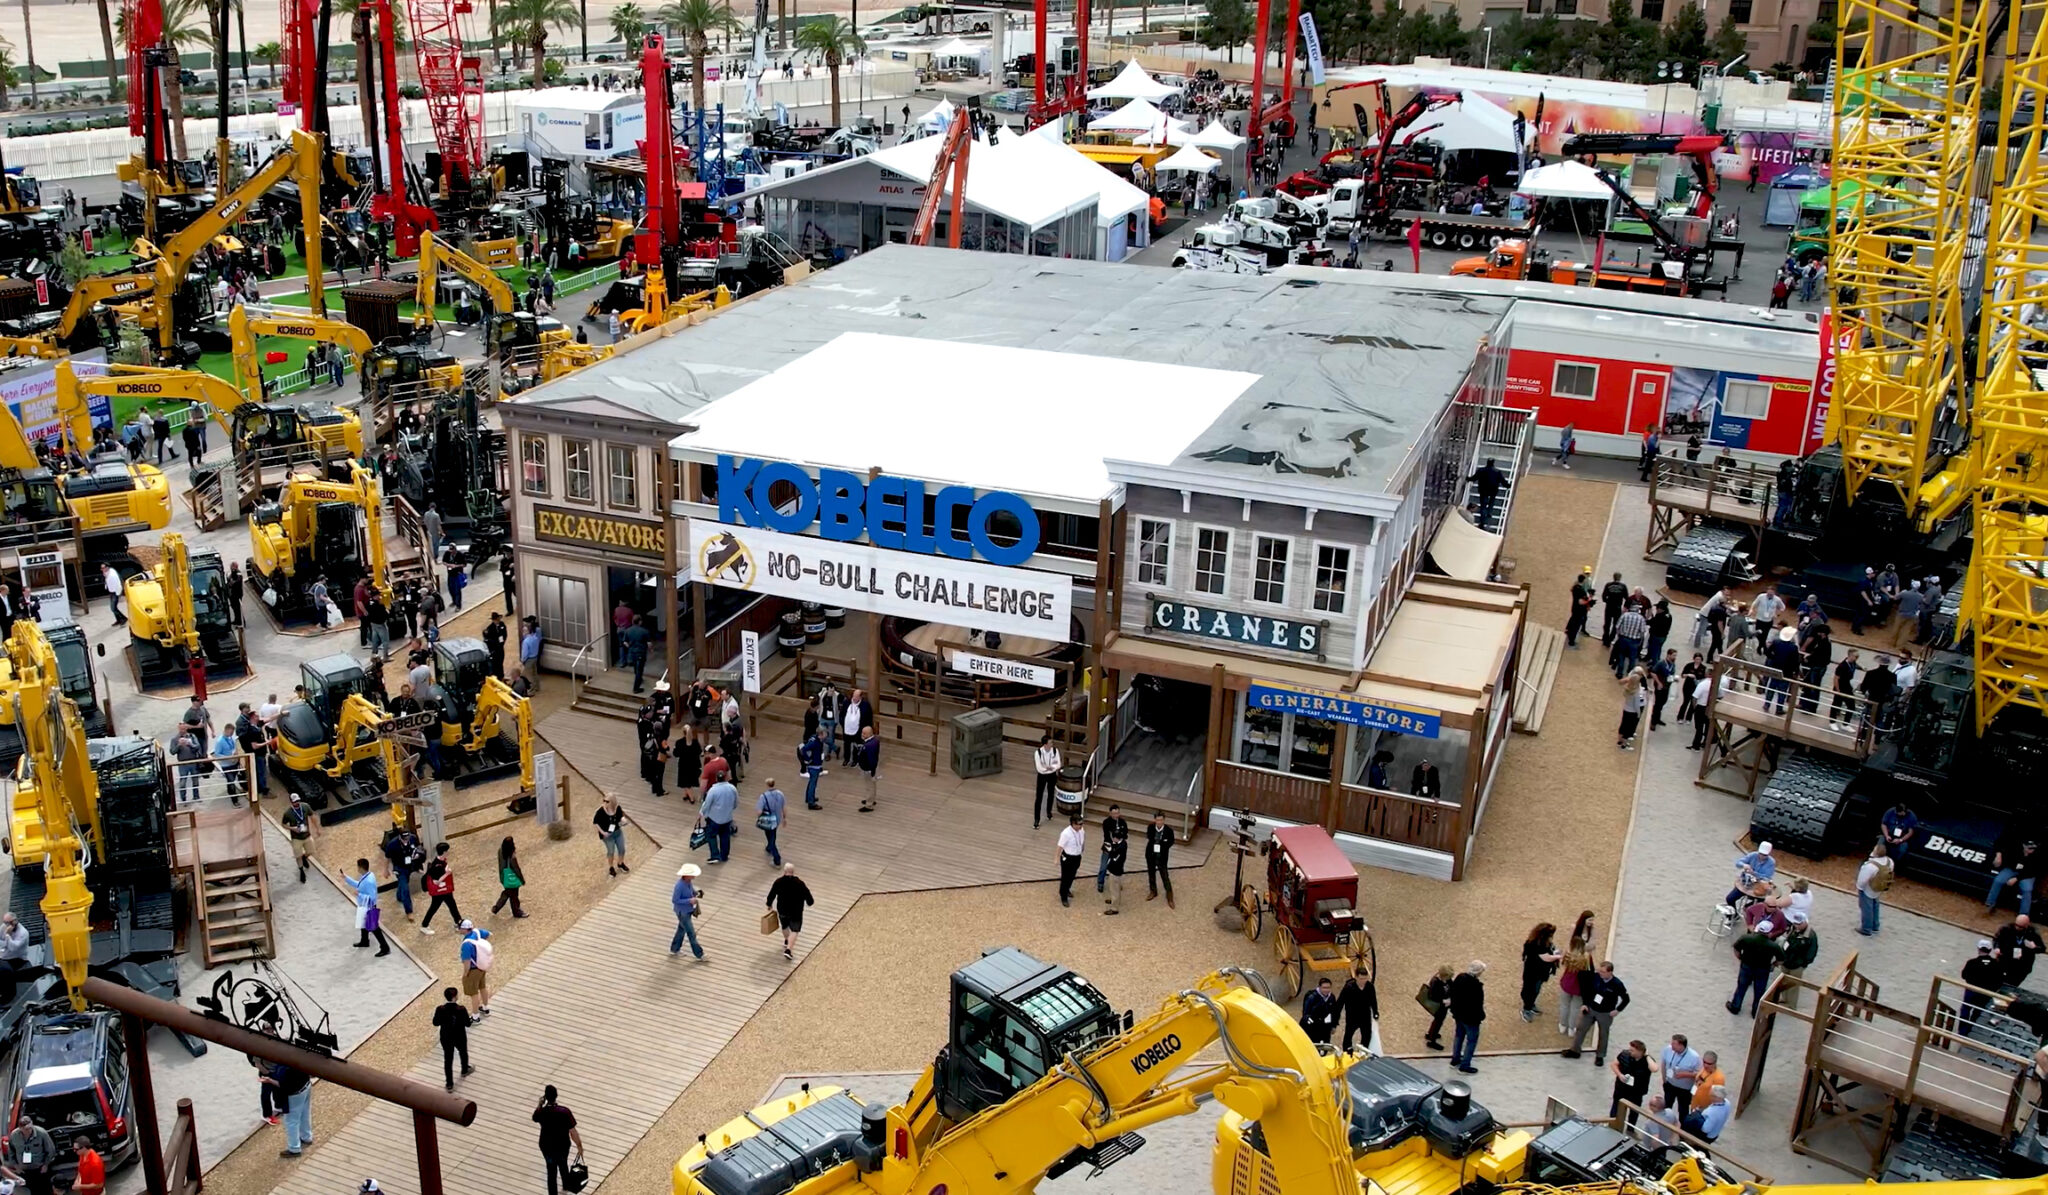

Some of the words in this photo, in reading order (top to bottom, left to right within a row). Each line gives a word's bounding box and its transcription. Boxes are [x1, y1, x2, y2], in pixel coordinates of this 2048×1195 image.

[277, 104, 296, 114] EXIT
[548, 119, 582, 127] COMANSA
[879, 185, 904, 194] ATLAS
[276, 325, 316, 337] KOBELCO
[116, 383, 162, 394] KOBELCO
[303, 488, 337, 500] KOBELCO
[717, 453, 1041, 566] KOBELCO
[537, 510, 664, 552] EXCAVATORS
[768, 550, 884, 596] NO-BULL
[895, 571, 1055, 621] CHALLENGE
[1155, 602, 1316, 650] CRANES
[746, 637, 755, 659] EXIT
[746, 660, 755, 681] ONLY
[969, 658, 1003, 675] ENTER
[1006, 665, 1035, 681] HERE
[378, 713, 432, 733] KOBELCO
[1260, 694, 1352, 714] GENERAL
[1362, 707, 1427, 733] STORE
[1327, 713, 1358, 723] WEARABLES
[1130, 1033, 1182, 1076] KOBELCO
